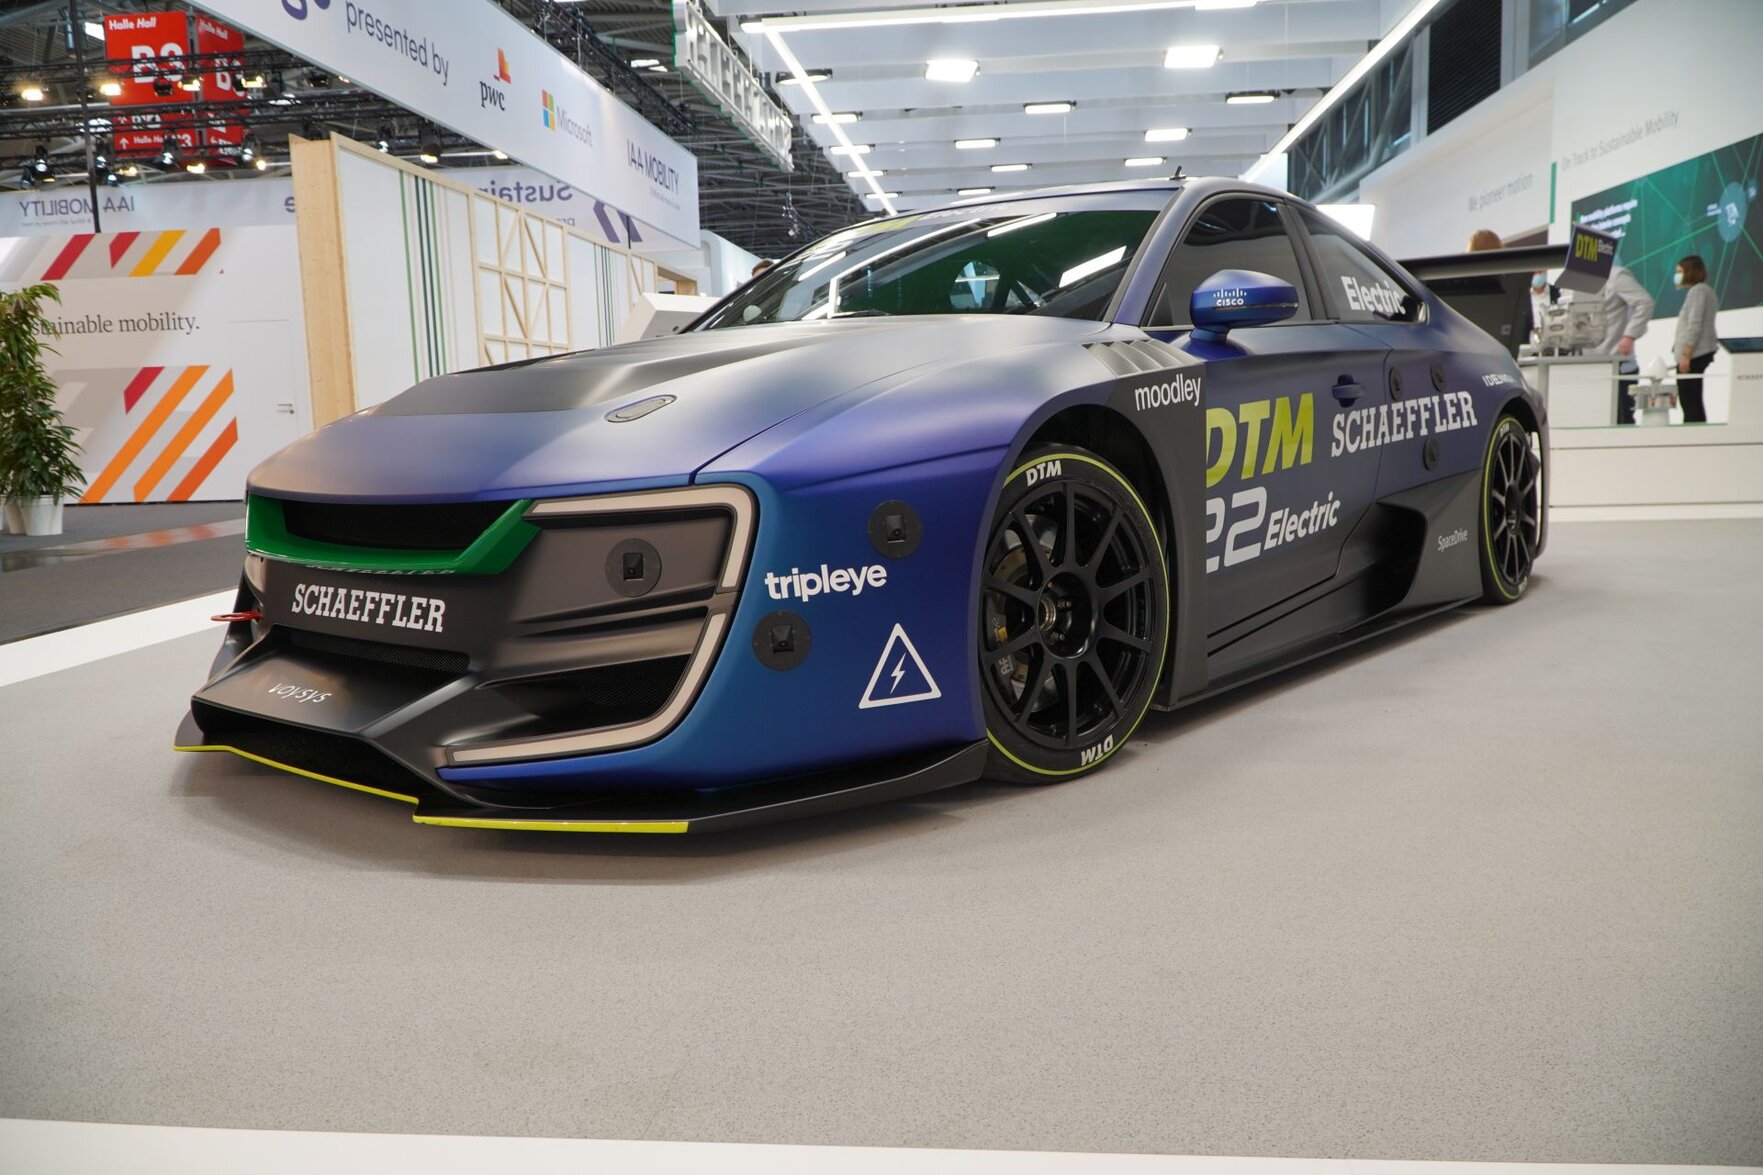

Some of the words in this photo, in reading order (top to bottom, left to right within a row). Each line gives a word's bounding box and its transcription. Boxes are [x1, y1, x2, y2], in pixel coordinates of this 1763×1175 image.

[109, 19, 135, 30] Halle
[136, 16, 157, 28] Hall
[345, 1, 428, 68] presented
[431, 42, 449, 87] by
[479, 81, 505, 111] pwc
[556, 106, 594, 147] Microsoft
[626, 139, 644, 175] IAA
[645, 151, 679, 195] MOBILITY
[1574, 233, 1598, 262] DTM
[1341, 275, 1407, 315] Electric
[118, 312, 200, 335] mobility.
[1135, 373, 1201, 411] moodley
[1206, 392, 1314, 488] DTM
[1331, 391, 1478, 457] SCHAEFFLER
[1026, 460, 1062, 487] DTM
[1264, 491, 1341, 550] Electric
[1438, 529, 1468, 553] SpaceDrive
[764, 564, 887, 602] tripleye
[291, 583, 446, 632] SCHAEFFLER
[1081, 734, 1114, 767] DTM
